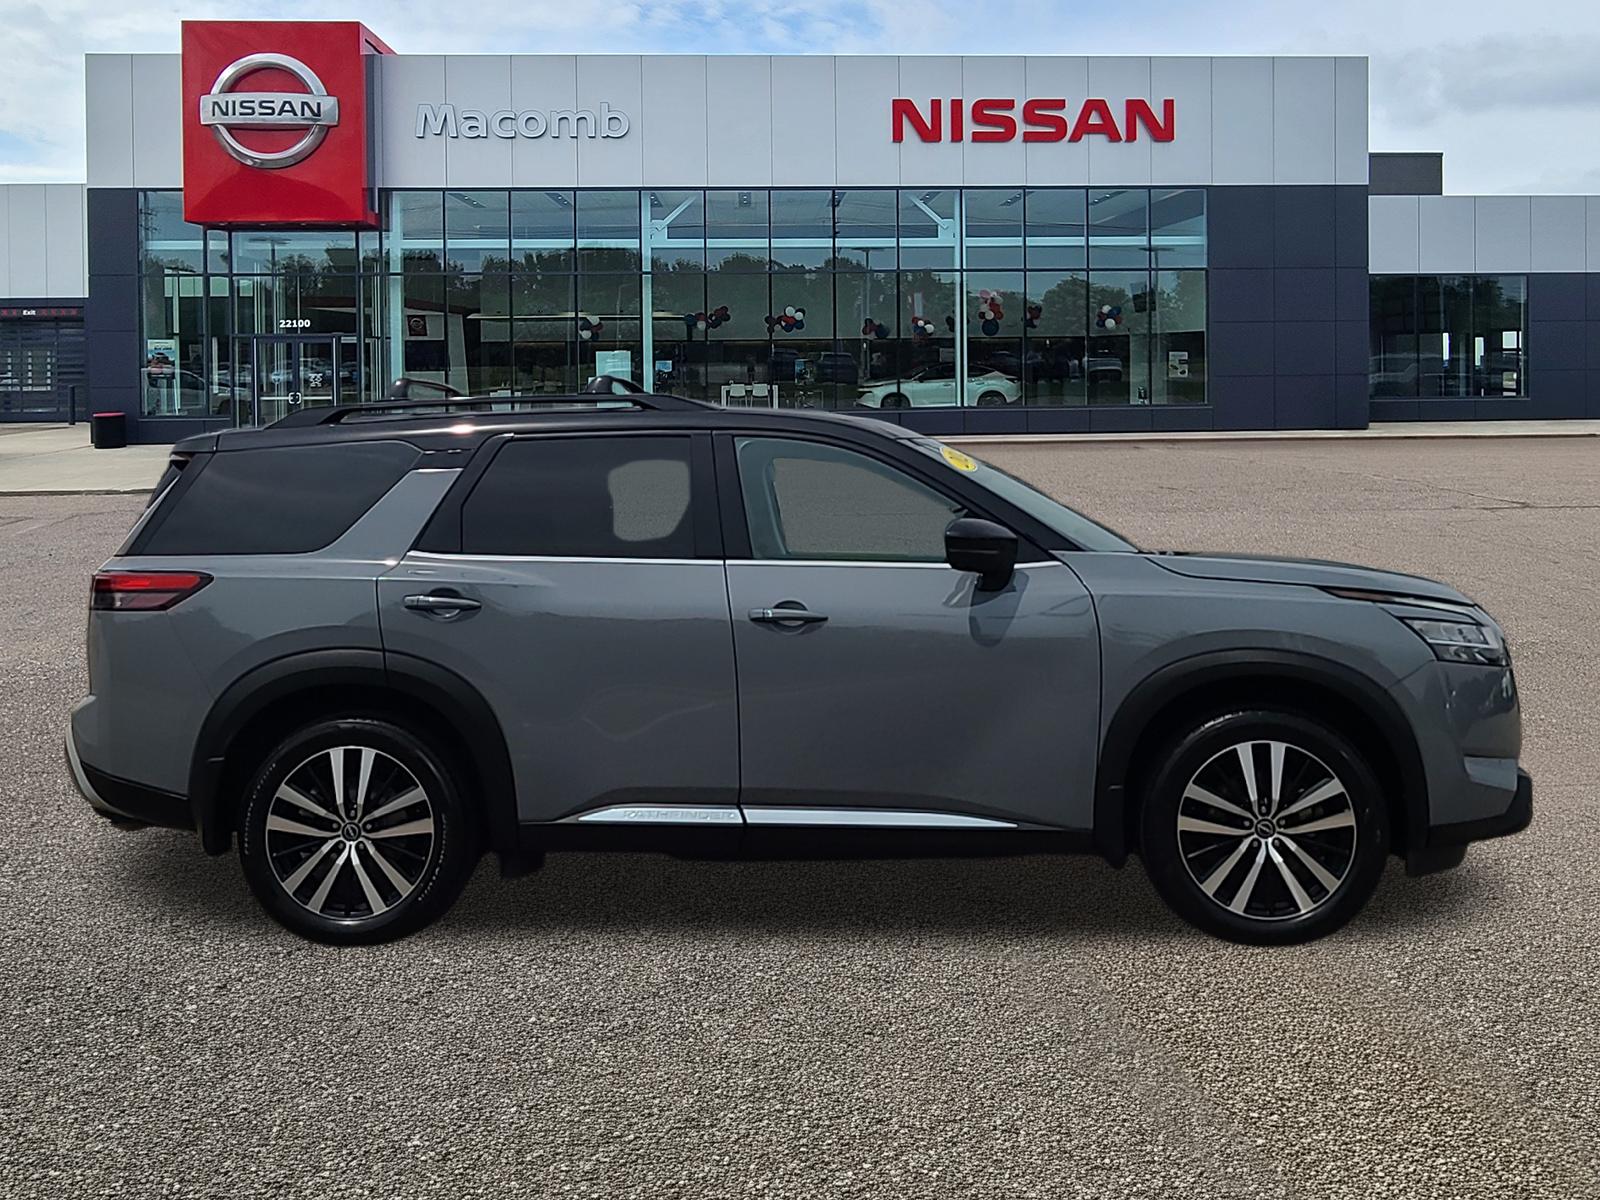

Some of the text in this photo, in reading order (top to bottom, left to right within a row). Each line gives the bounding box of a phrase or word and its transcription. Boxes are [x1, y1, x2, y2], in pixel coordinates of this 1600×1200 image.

[211, 100, 322, 118] NISSAN
[414, 101, 631, 139] Macomb
[892, 98, 1175, 143] NISSAN
[22, 308, 36, 316] Exit
[279, 319, 311, 328] 22100
